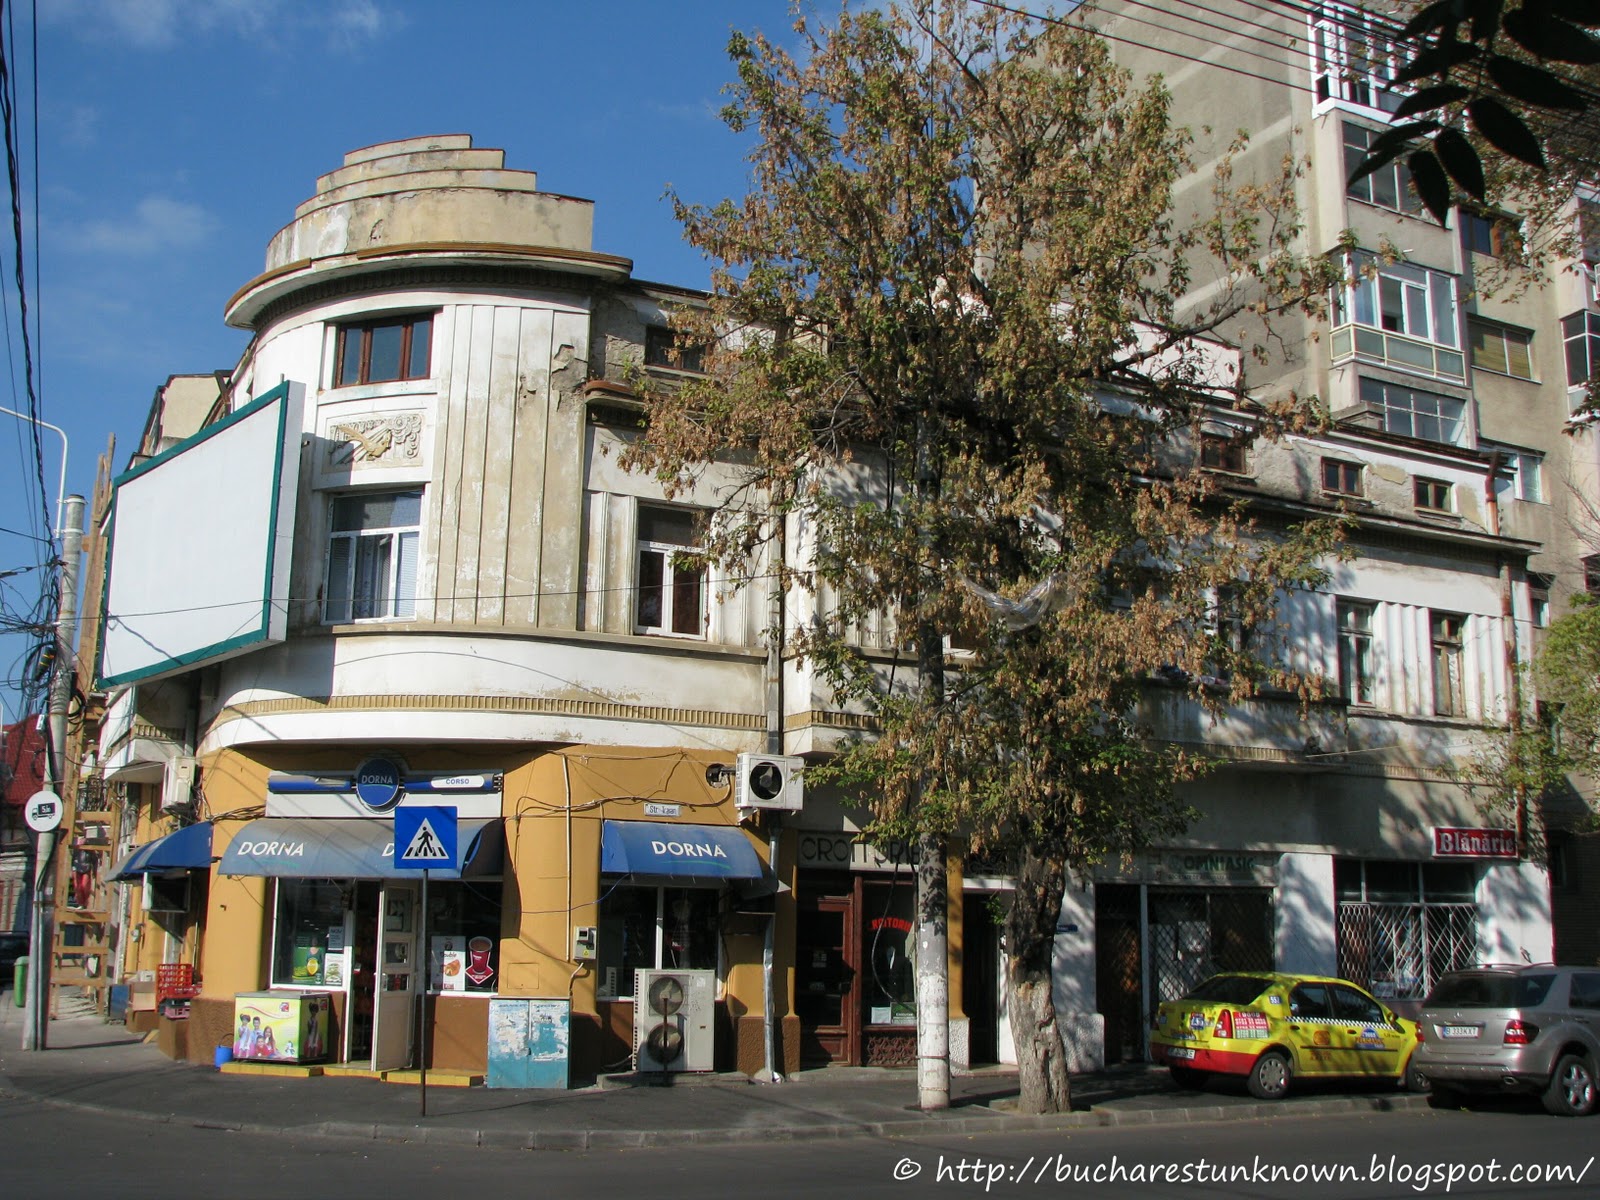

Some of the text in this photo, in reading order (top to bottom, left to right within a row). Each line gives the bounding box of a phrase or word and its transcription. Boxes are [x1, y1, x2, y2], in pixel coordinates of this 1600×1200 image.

[361, 775, 393, 784] DORNA
[237, 841, 304, 856] DORNA
[651, 840, 727, 858] DORNA
[1439, 831, 1514, 854] Blănărie
